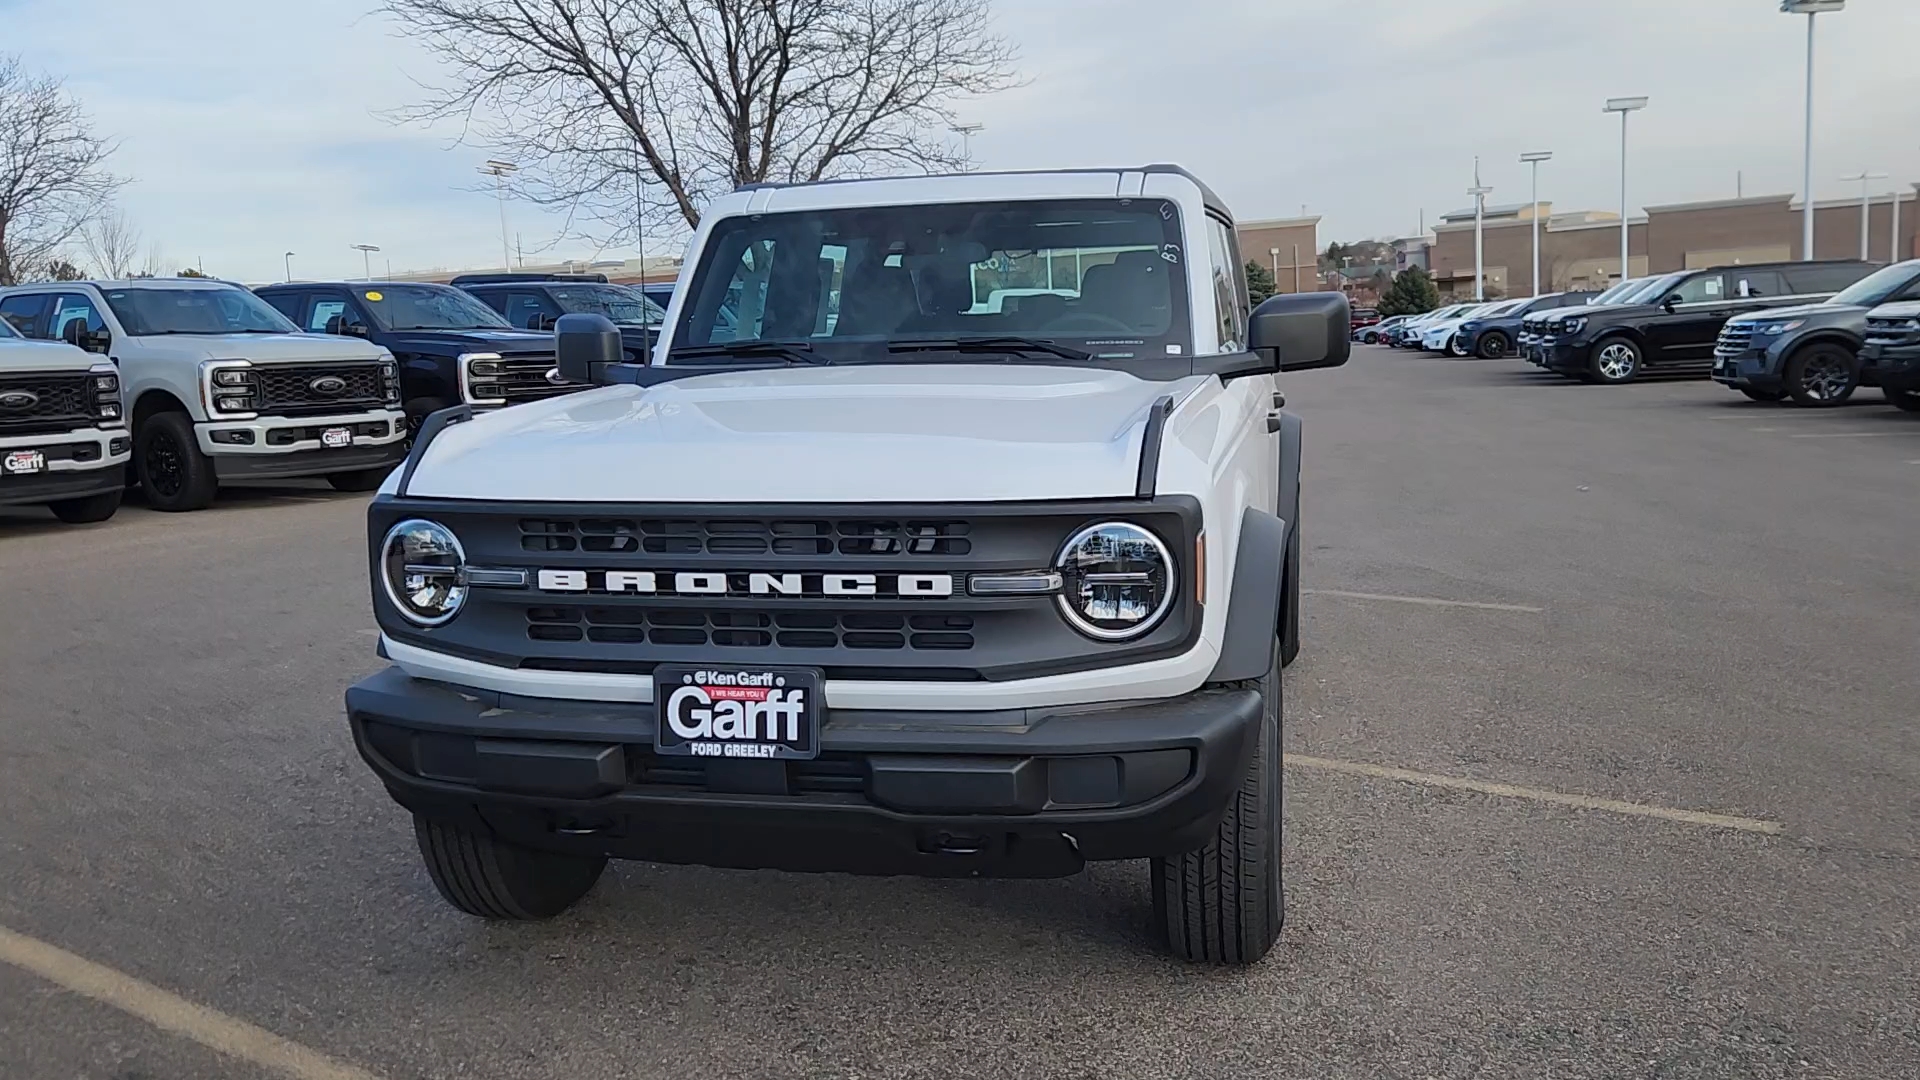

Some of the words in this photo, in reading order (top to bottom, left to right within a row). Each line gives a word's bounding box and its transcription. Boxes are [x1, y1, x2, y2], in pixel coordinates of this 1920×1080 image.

[1160, 243, 1180, 264] B3
[537, 569, 953, 596] BRONCO
[708, 671, 736, 685] Ken
[737, 671, 773, 687] Garff
[746, 690, 760, 698] YOU
[667, 685, 804, 741] Garff
[691, 742, 722, 757] FORD
[724, 743, 777, 759] GREELEY
